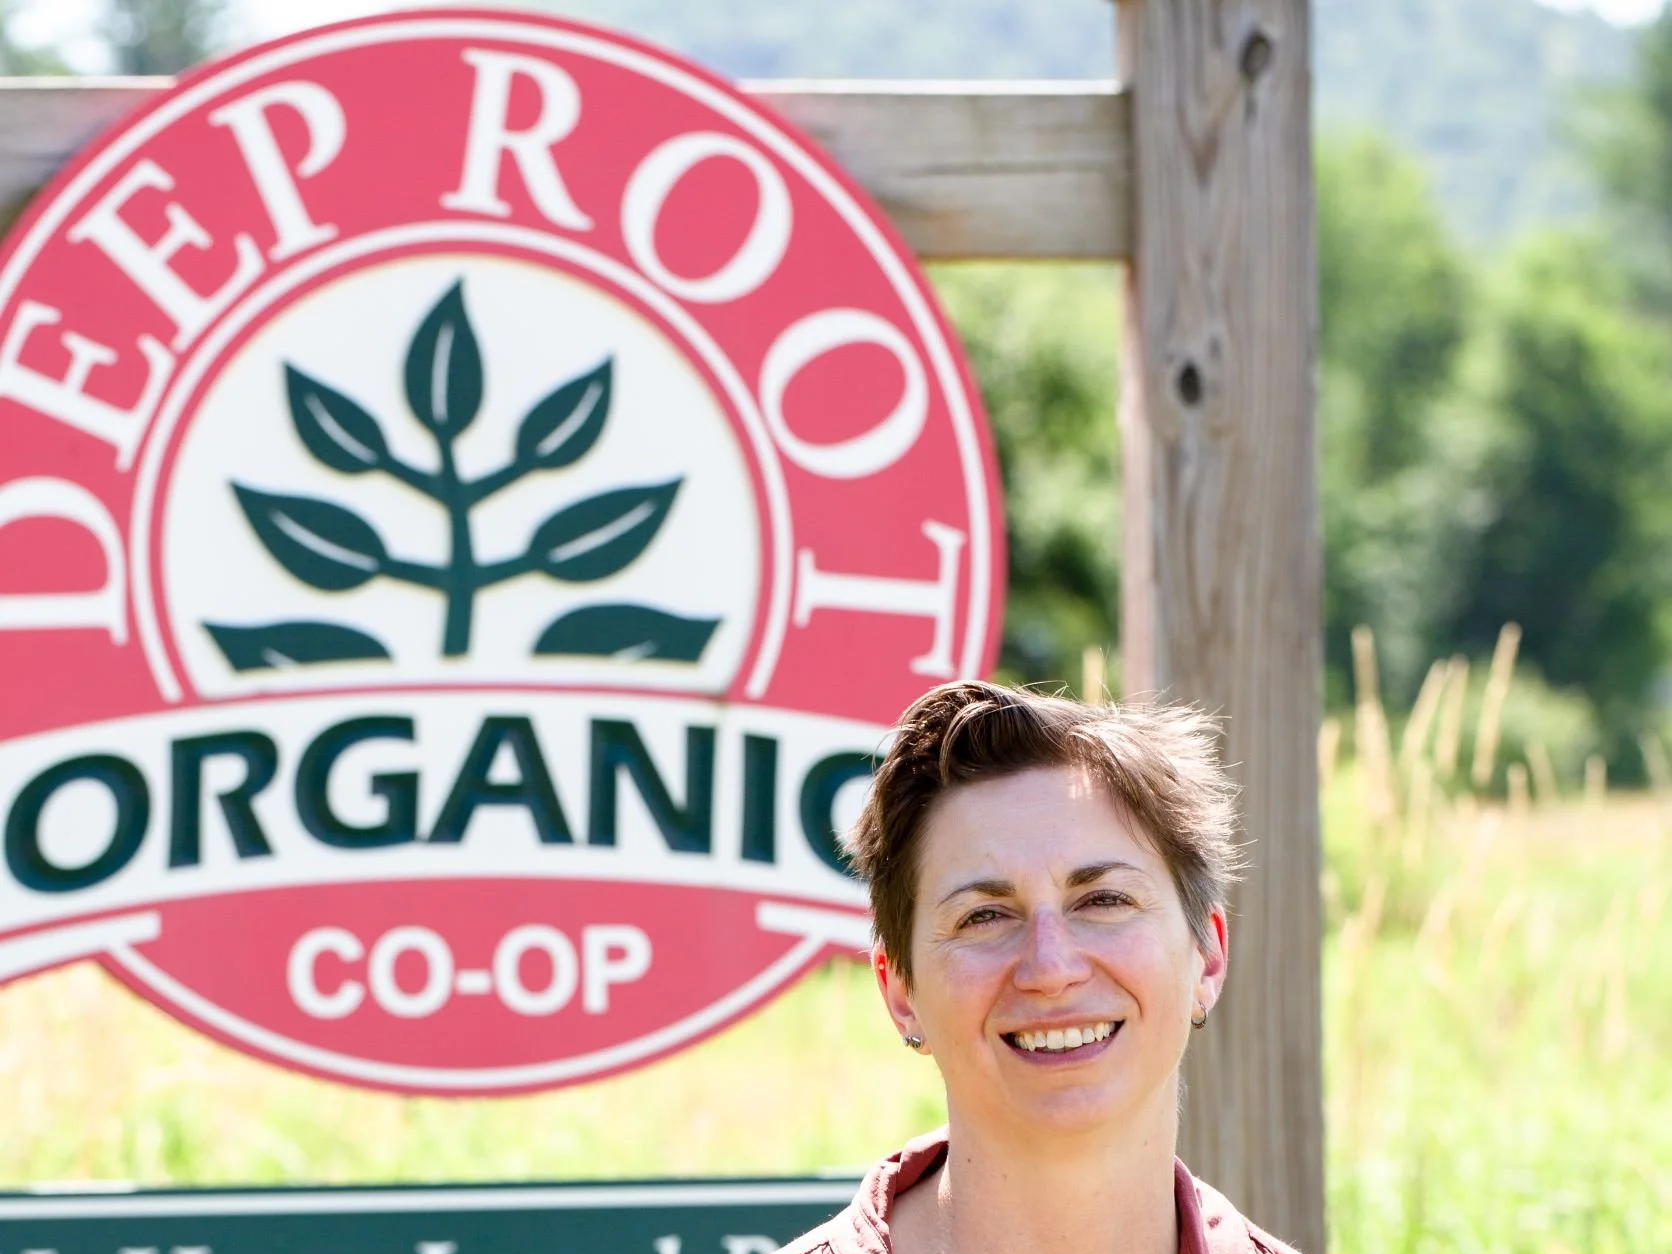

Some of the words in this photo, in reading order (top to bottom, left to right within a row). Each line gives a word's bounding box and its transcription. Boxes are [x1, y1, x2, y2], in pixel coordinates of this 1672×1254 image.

[0, 80, 347, 646] DEEP
[440, 48, 966, 679] ROOT
[4, 714, 886, 893] ORGANIC
[286, 924, 653, 1019] CO-OP
